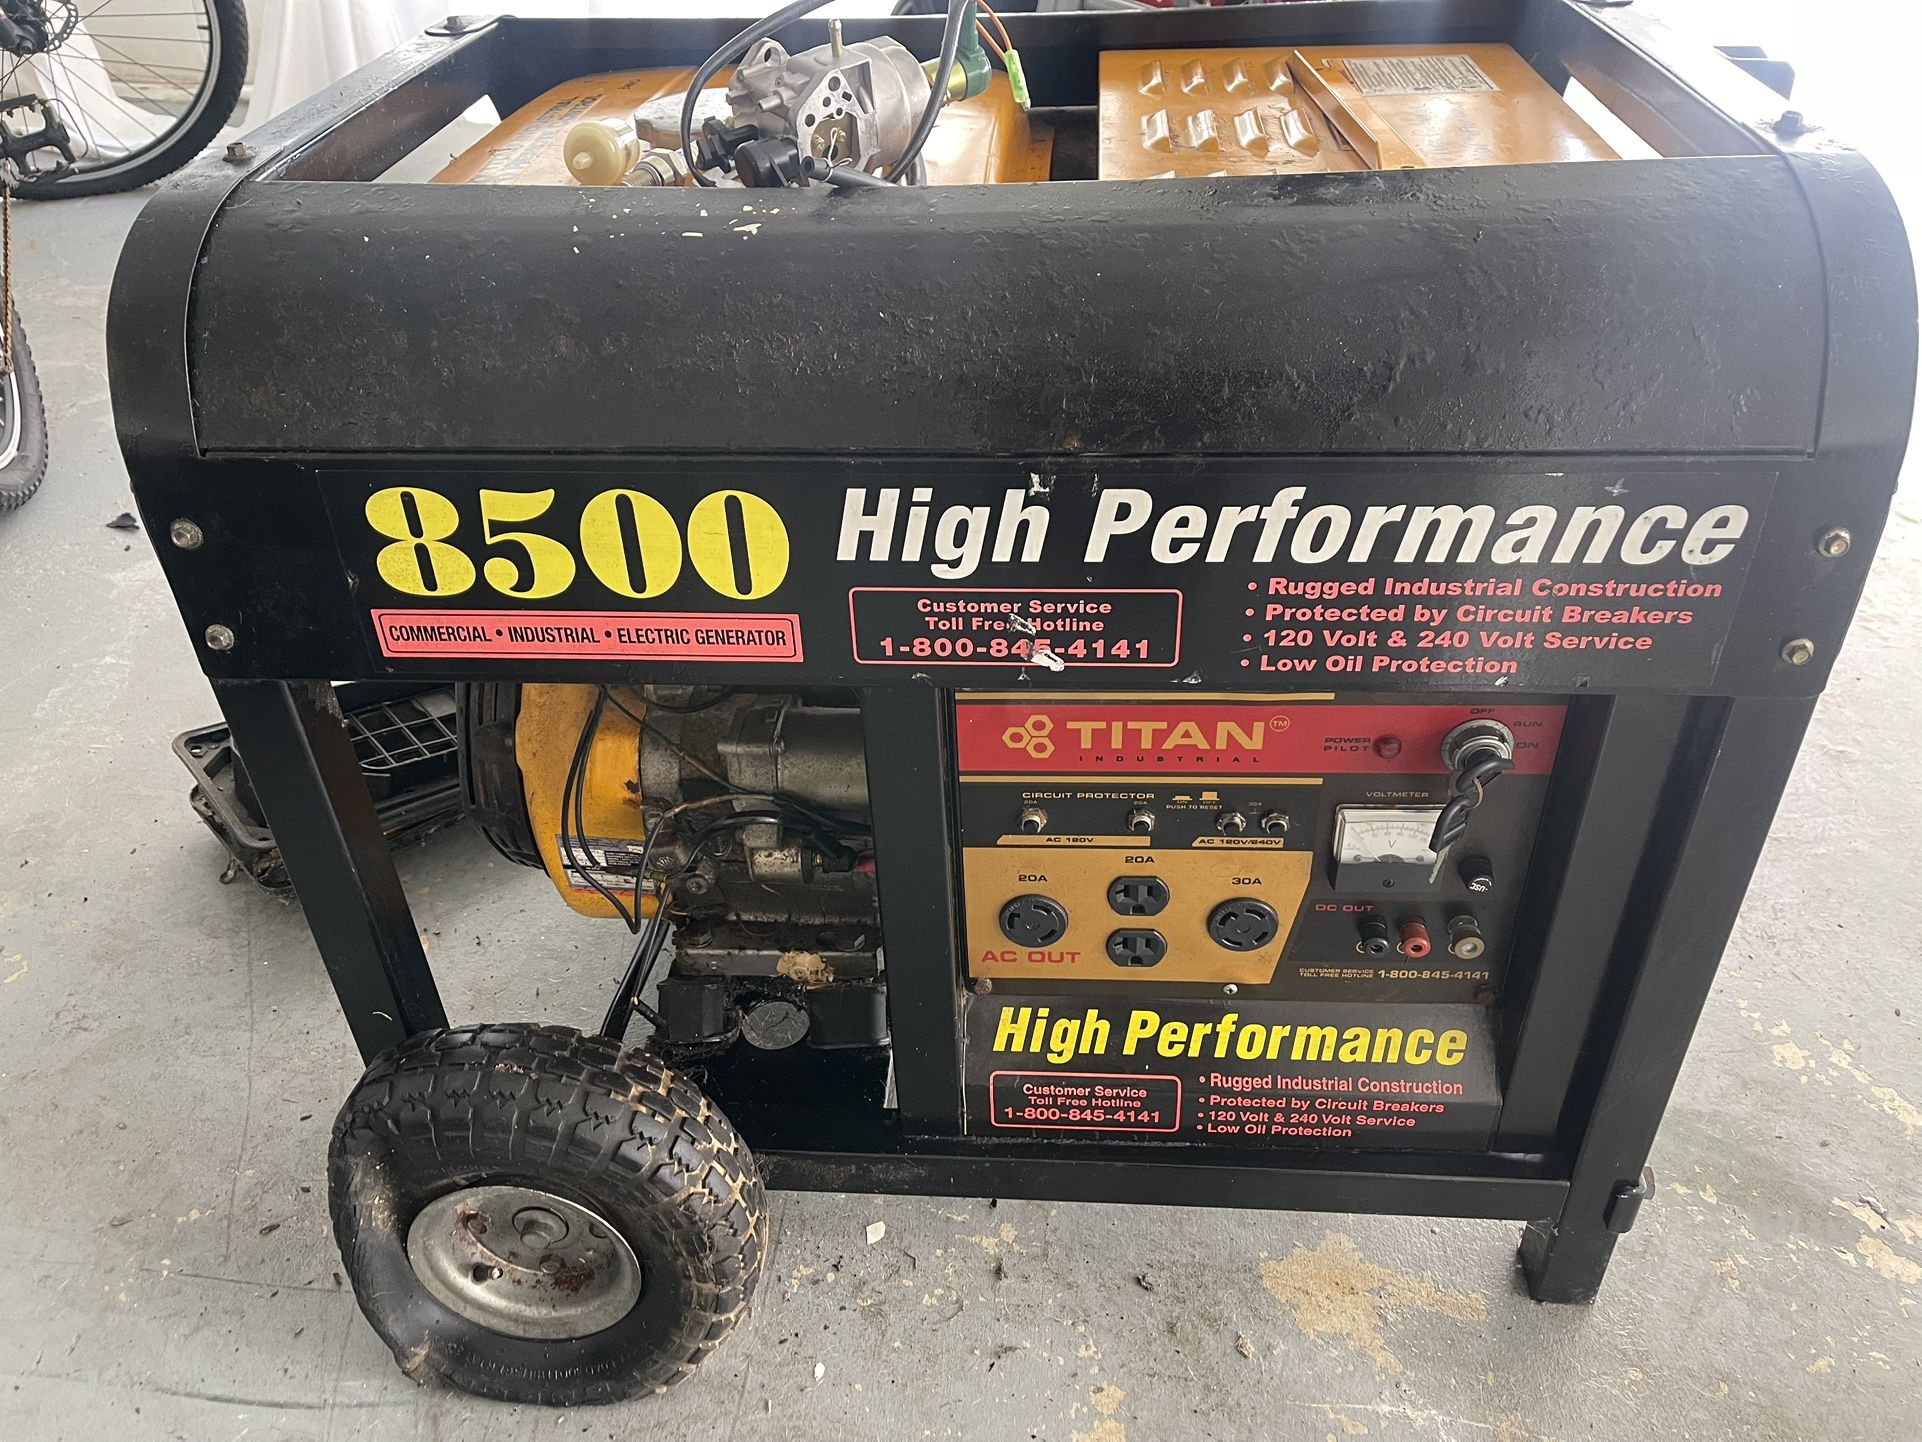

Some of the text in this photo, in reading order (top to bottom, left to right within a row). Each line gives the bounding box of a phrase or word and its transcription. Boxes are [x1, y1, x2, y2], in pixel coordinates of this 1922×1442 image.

[836, 486, 1749, 580] High Performance
[365, 487, 790, 600] 8500
[1268, 578, 1723, 599] Rugged Industrial Construction
[917, 599, 1112, 615] Customer Service
[1265, 604, 1693, 627] Protected by Circuit Breakers
[925, 616, 1105, 632] Toll Fre Hotline
[388, 625, 787, 647] COMMERCIAL INDUSTRIAL ELECTRIC GENERATOR
[1263, 630, 1653, 651] 120 Volt & 240 Volt Service
[1259, 655, 1518, 674] Low Oil Protection
[1513, 720, 1543, 728] RUN
[1066, 721, 1265, 750] TITAN
[1515, 741, 1539, 749] ON
[1077, 792, 1155, 800] PROTECTOR
[1124, 855, 1155, 864] 20A
[1018, 874, 1048, 882] 20A
[1231, 877, 1262, 885] 30A
[1315, 904, 1375, 912] DC OUT
[981, 951, 1081, 964] AC OUT
[1378, 970, 1490, 980] 1-800-845-4141
[992, 1006, 1469, 1066] High Performance
[1023, 1084, 1148, 1098] Customer Service
[1210, 1073, 1463, 1094] Rugged Industrial Construction
[1028, 1096, 1141, 1108] Toll Free Hotline
[1209, 1095, 1444, 1112] Protected by Circuit Breakers
[1004, 1106, 1160, 1124] 1-800-845-4141
[1208, 1111, 1416, 1126] 120 Volt & 240 Volt Service
[1207, 1122, 1352, 1137] Low Oil Protection
